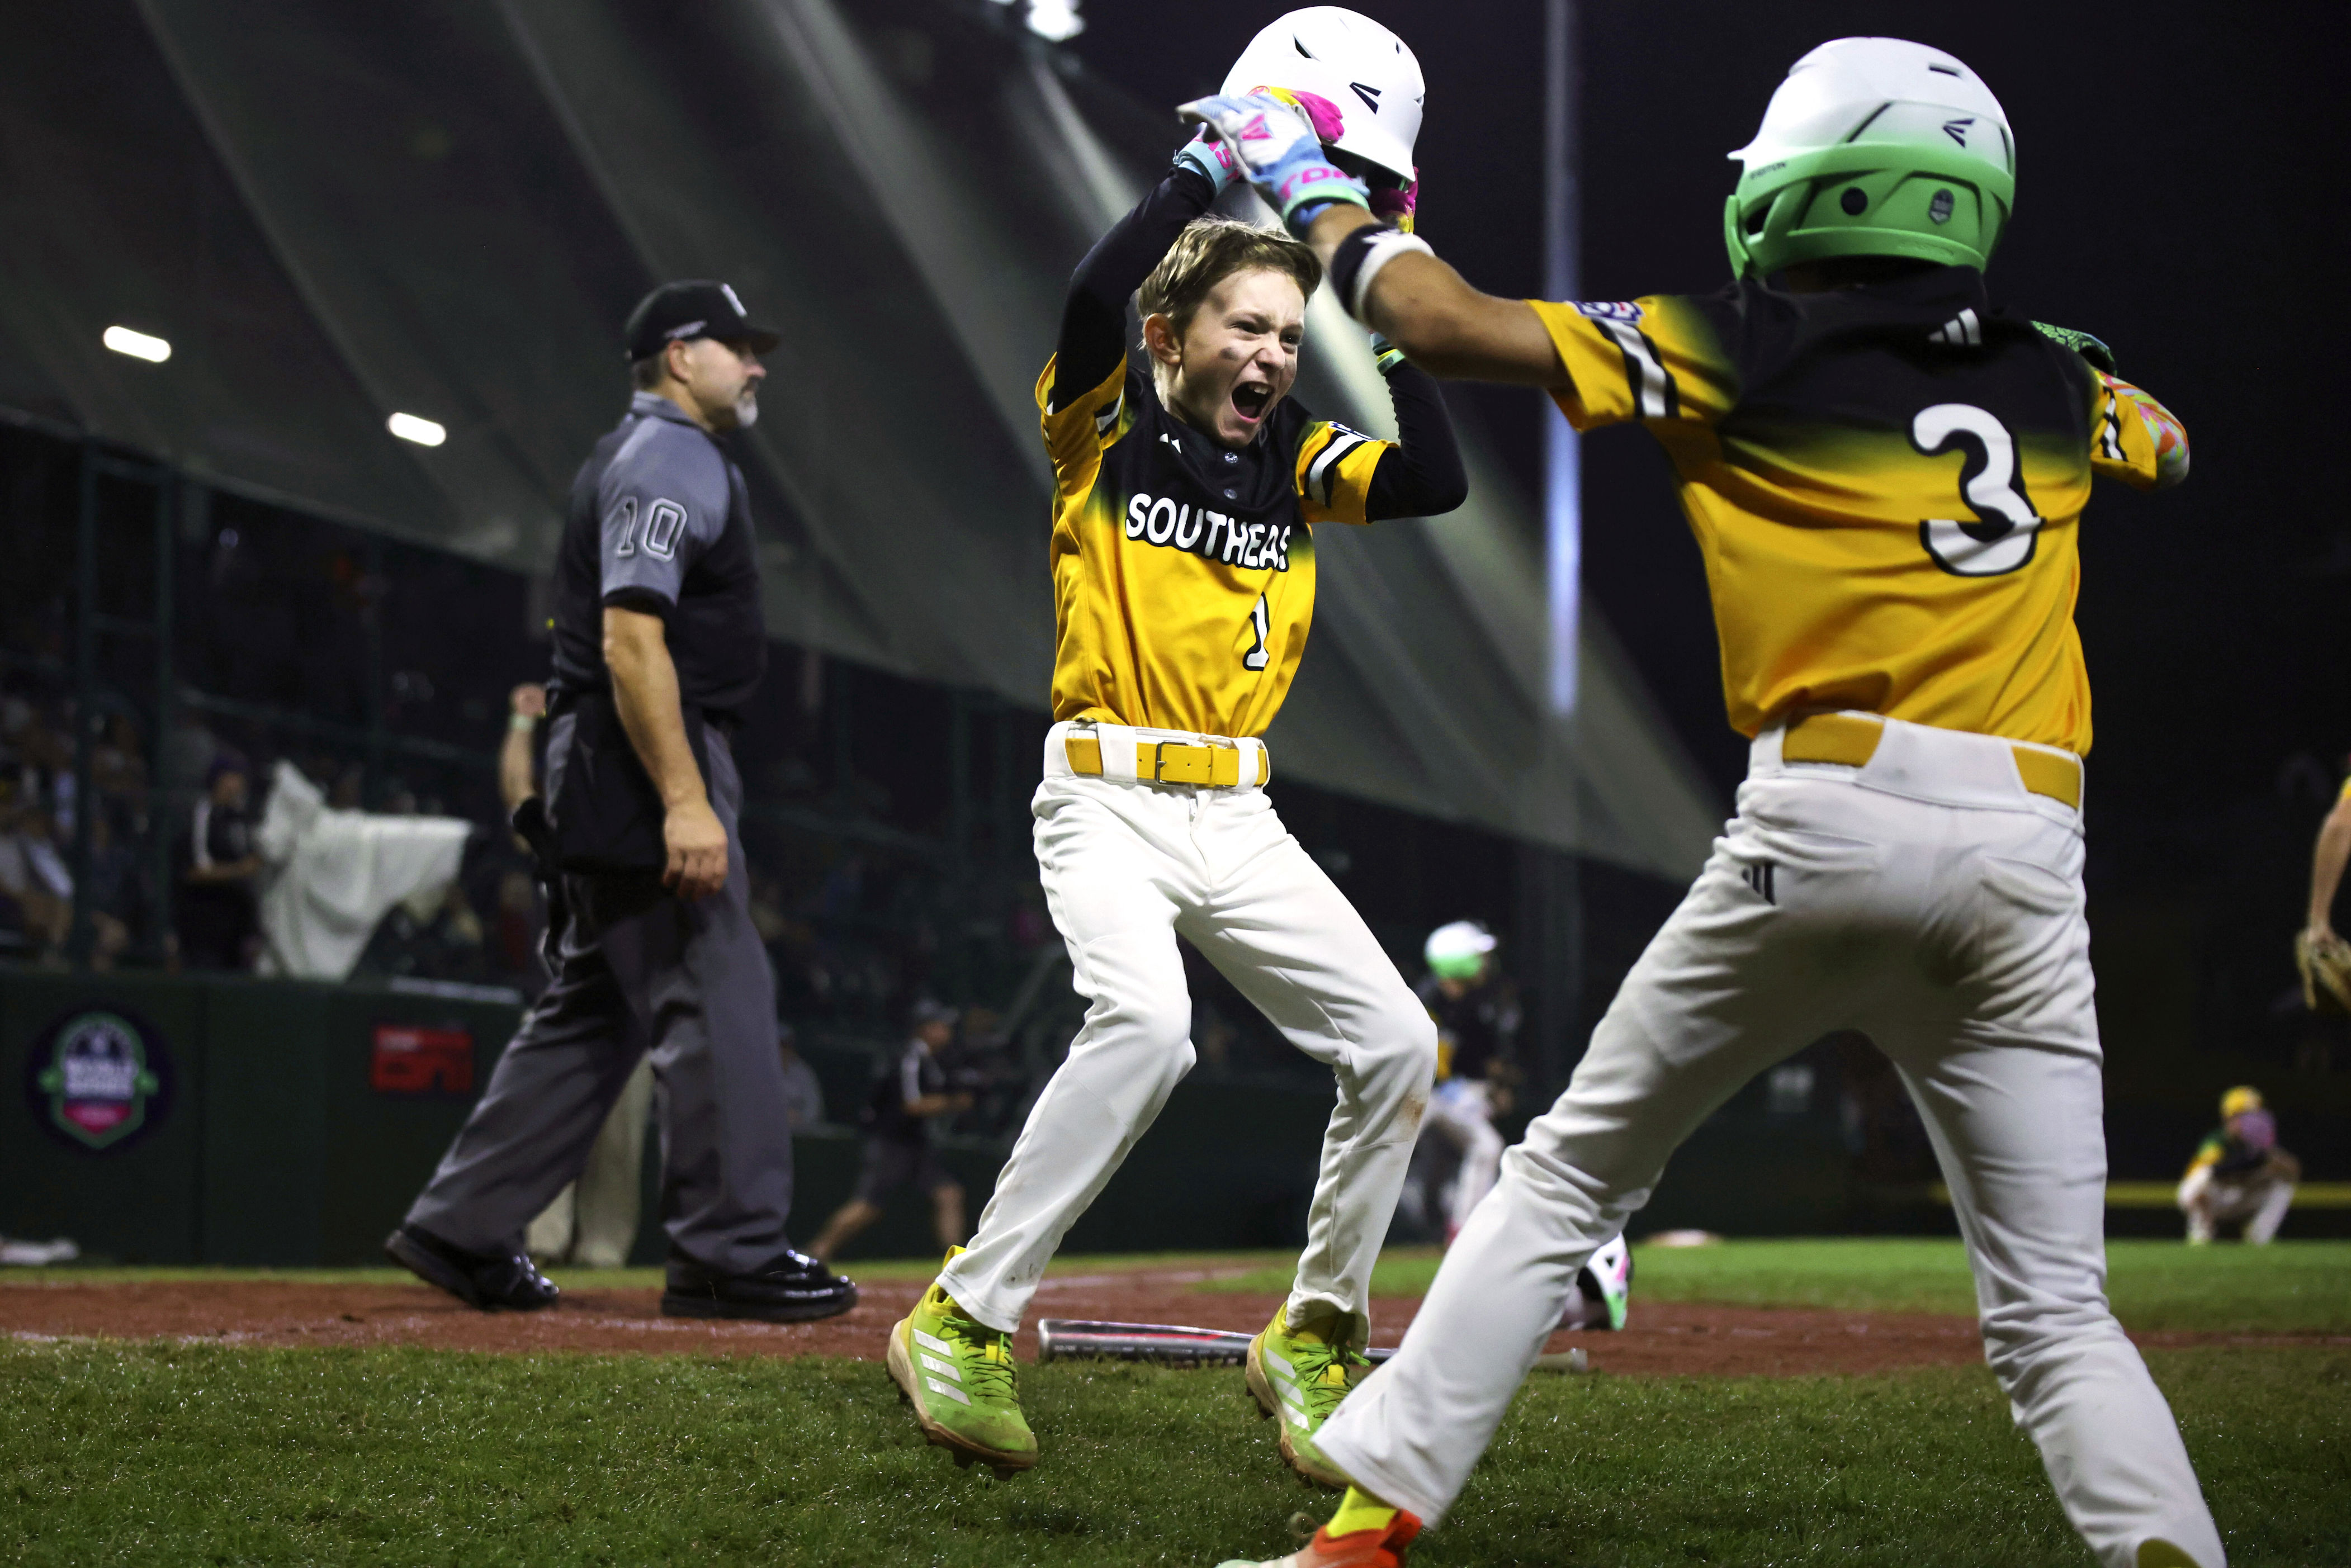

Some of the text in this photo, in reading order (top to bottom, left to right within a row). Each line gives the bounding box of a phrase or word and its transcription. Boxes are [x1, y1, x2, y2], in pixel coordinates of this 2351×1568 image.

[1910, 402, 2043, 575] 3
[617, 496, 688, 561] 10
[1244, 593, 1270, 670] 1
